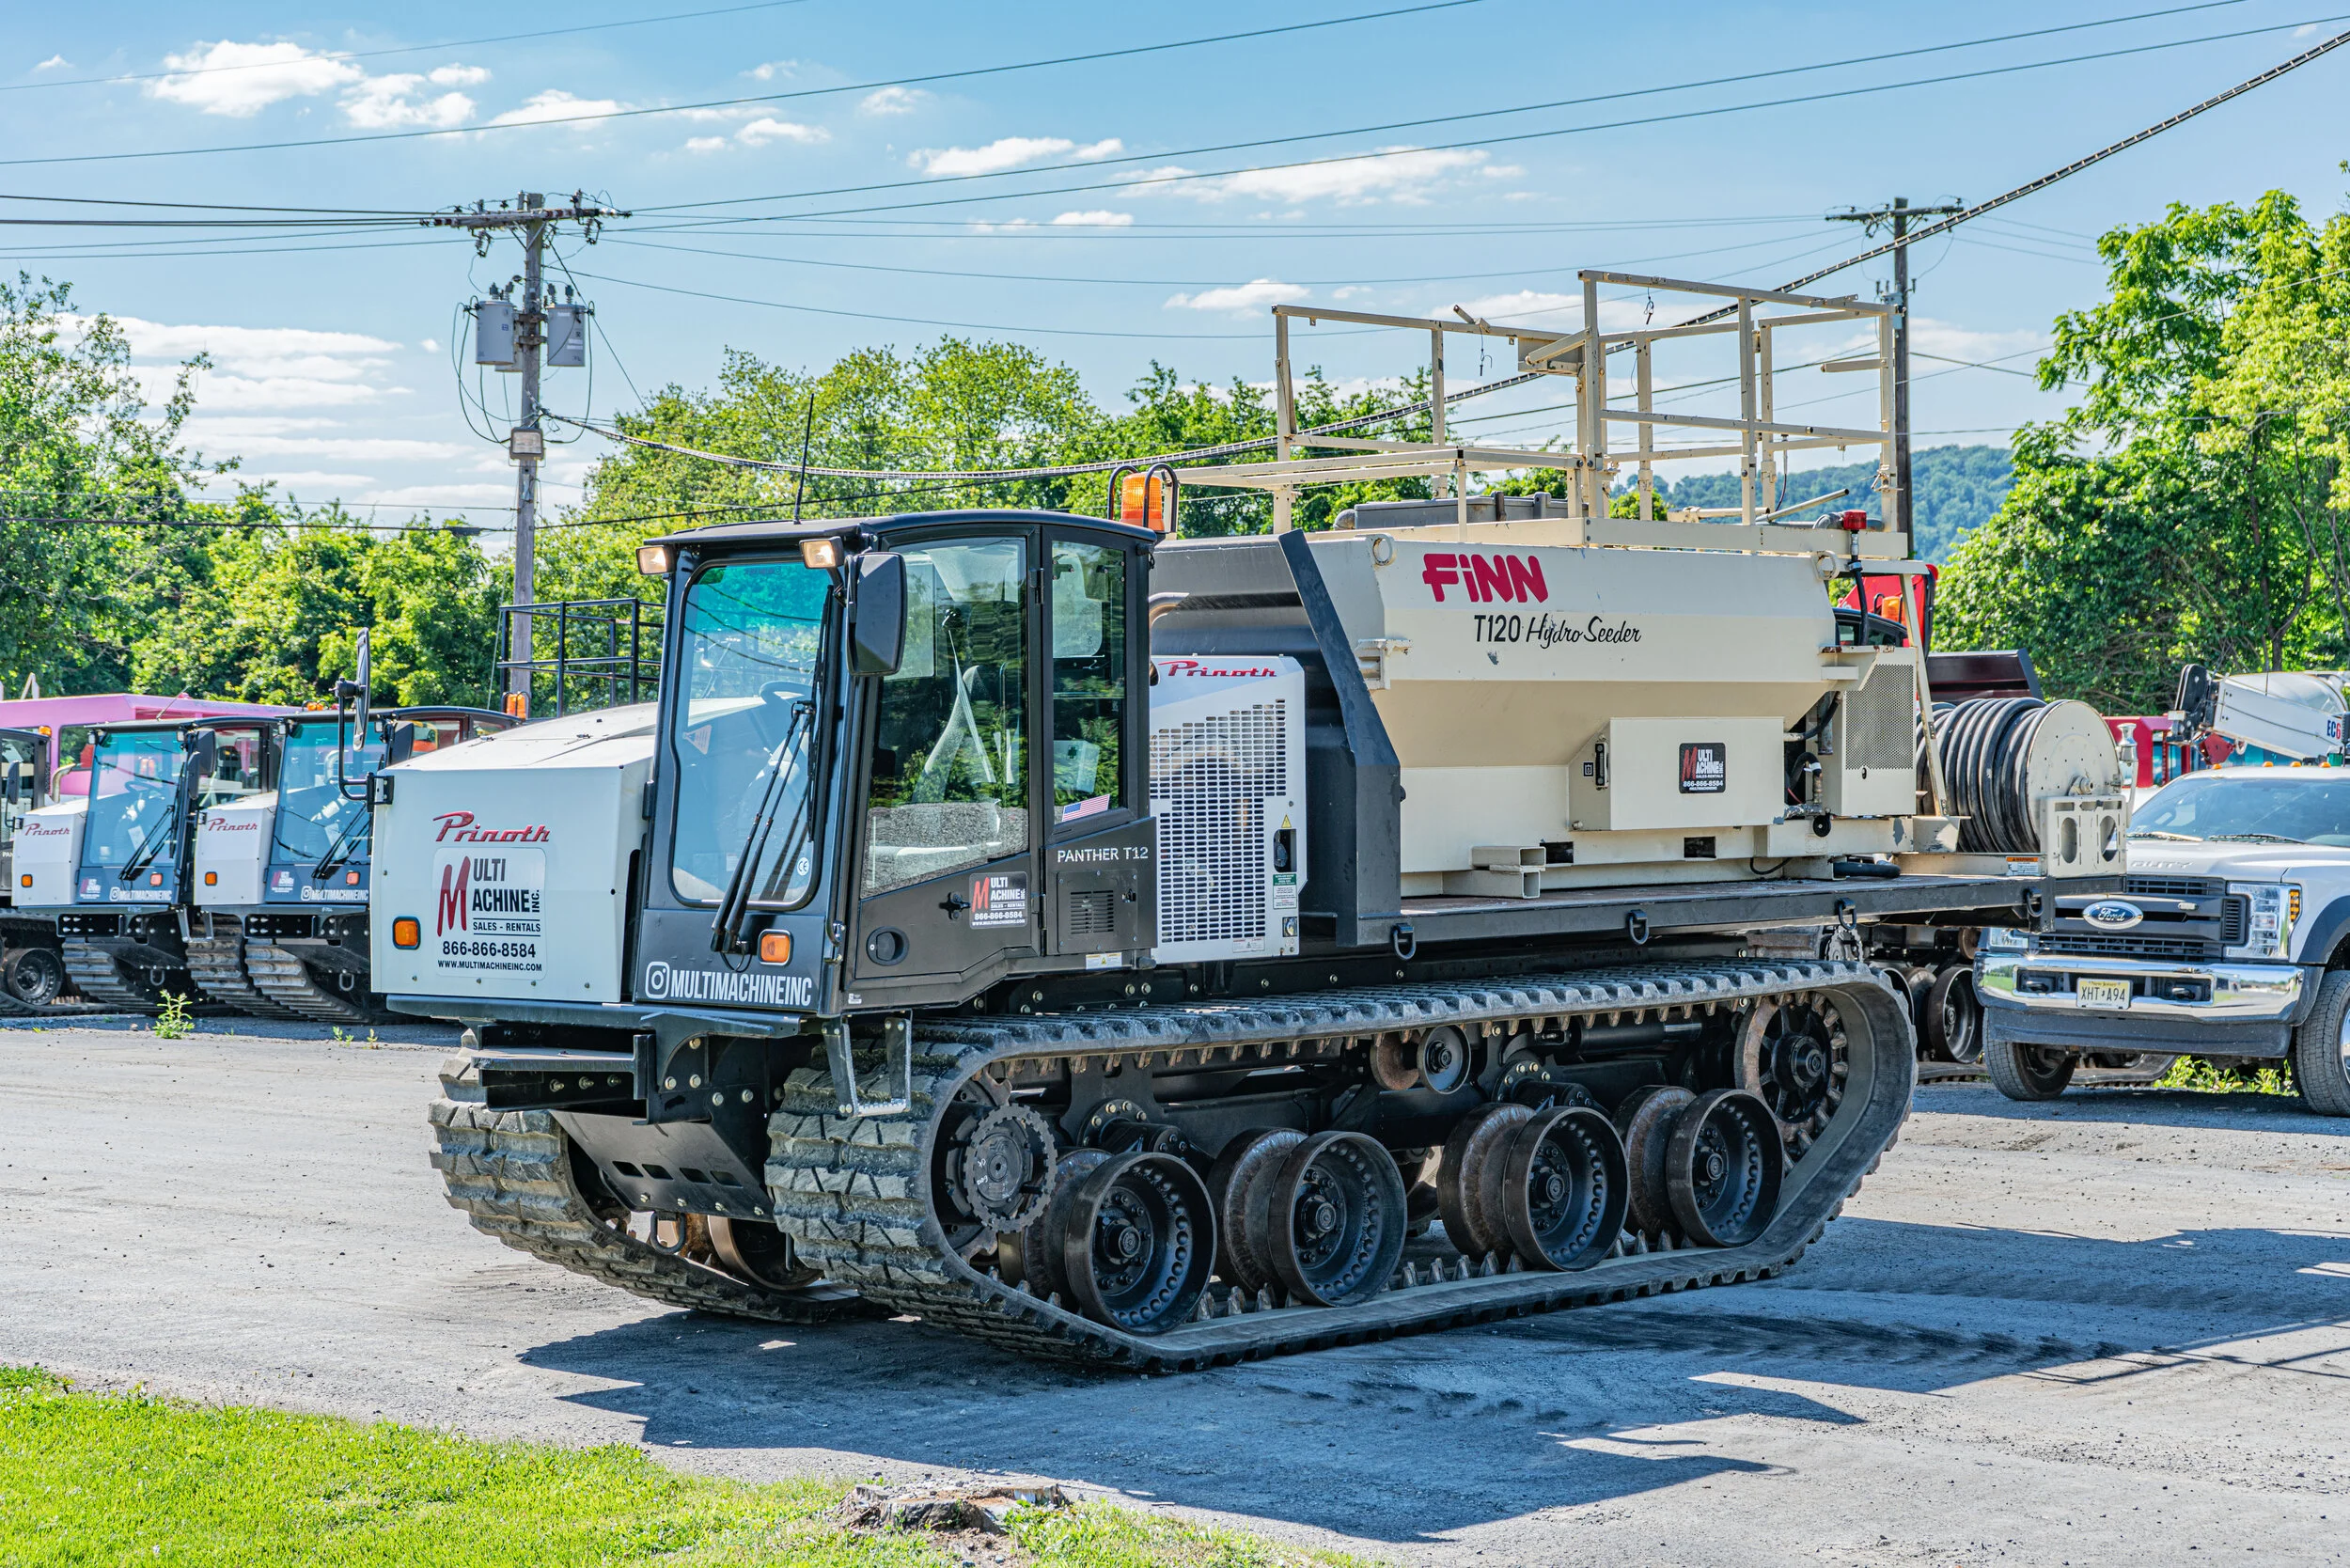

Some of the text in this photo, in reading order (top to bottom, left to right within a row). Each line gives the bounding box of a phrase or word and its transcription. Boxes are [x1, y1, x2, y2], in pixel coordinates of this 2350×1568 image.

[1474, 614, 1521, 643] T120
[1157, 660, 1277, 677] Prinoth
[24, 823, 70, 836] Prinoth
[208, 817, 258, 832] Prinoth
[432, 810, 551, 842] Prinoth
[1057, 846, 1149, 863] PANTHER T12
[974, 911, 1023, 920] 866-866-8584
[2097, 907, 2125, 923] Ford
[473, 922, 497, 932] SALES
[506, 922, 541, 933] RENTALS
[442, 941, 536, 958] 866-866-8584
[438, 960, 542, 972] WWW.MULTIMACHINEINC.COM
[670, 969, 812, 1007] MULTIMACHINEINC
